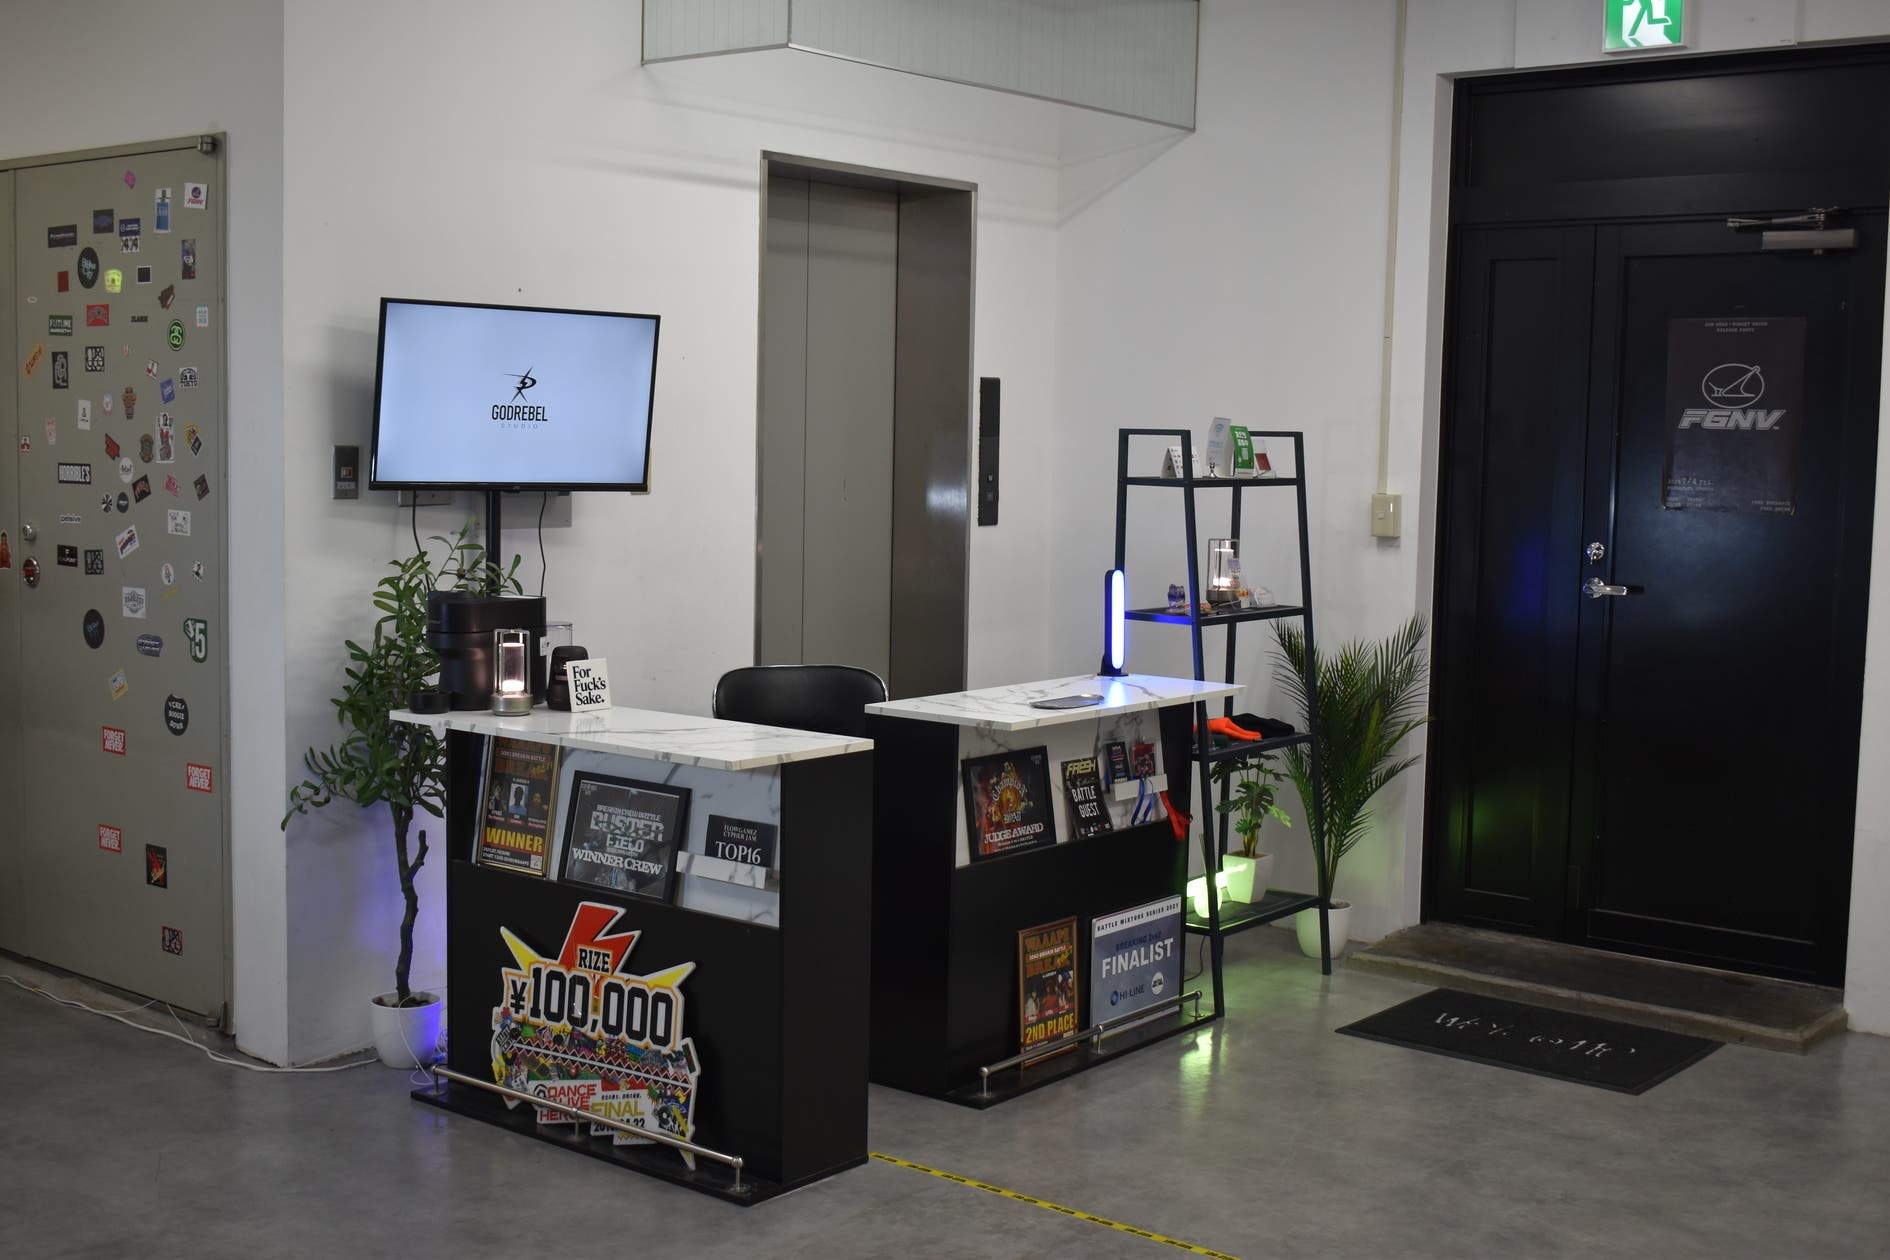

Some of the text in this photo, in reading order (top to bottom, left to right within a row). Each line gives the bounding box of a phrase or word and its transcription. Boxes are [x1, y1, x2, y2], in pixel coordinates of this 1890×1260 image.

[492, 404, 548, 422] GODREBEL
[1678, 408, 1786, 430] FGNV
[194, 622, 206, 659] 5
[572, 665, 592, 679] For
[574, 677, 607, 692] Fuck's
[575, 691, 605, 706] Sake.
[103, 728, 125, 743] FORGET
[188, 765, 211, 780] FORGET
[1066, 760, 1097, 777] FRESH
[1071, 785, 1097, 803] BATTLE
[1078, 802, 1100, 819] GUEST
[99, 826, 121, 841] FORGET
[486, 827, 544, 853] WINNER
[984, 829, 1011, 844] JUDGE
[1012, 822, 1044, 838] AWARD
[572, 848, 624, 868] WINNER
[624, 858, 663, 875] CREW
[715, 840, 762, 865] TOP16
[1097, 920, 1118, 932] BATTLE
[578, 947, 611, 973] RIZE
[1102, 937, 1175, 979] FINALIST
[510, 966, 673, 1048] ¥100,000
[1026, 1012, 1075, 1043] 2ND PLACE
[547, 1083, 597, 1098] DANCE
[591, 1100, 645, 1117] FINAL
